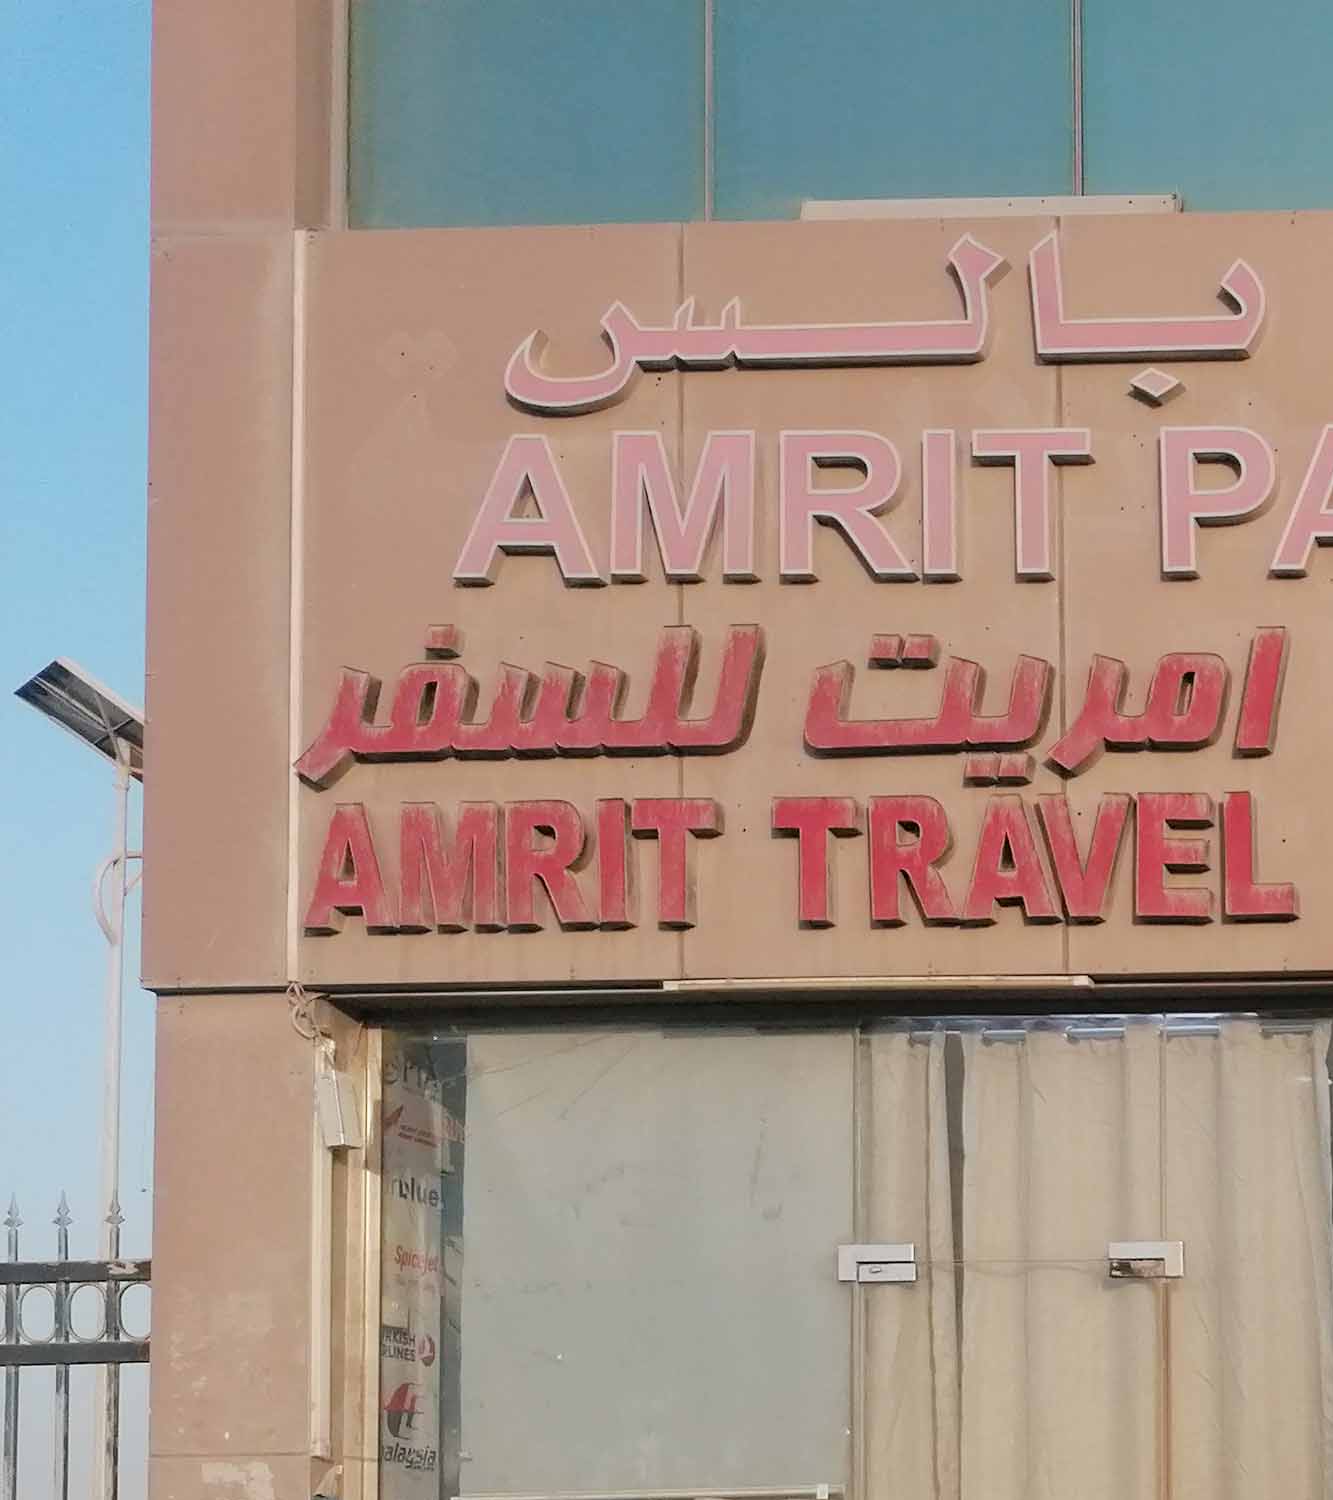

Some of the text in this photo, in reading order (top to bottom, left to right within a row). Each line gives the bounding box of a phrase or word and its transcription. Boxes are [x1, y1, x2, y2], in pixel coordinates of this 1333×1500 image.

[453, 427, 1096, 584] AMRIT
[294, 623, 1288, 787] امريت للسفر
[303, 790, 1300, 934] AMRIT TRAVEL
[382, 1443, 437, 1466] alaysia
